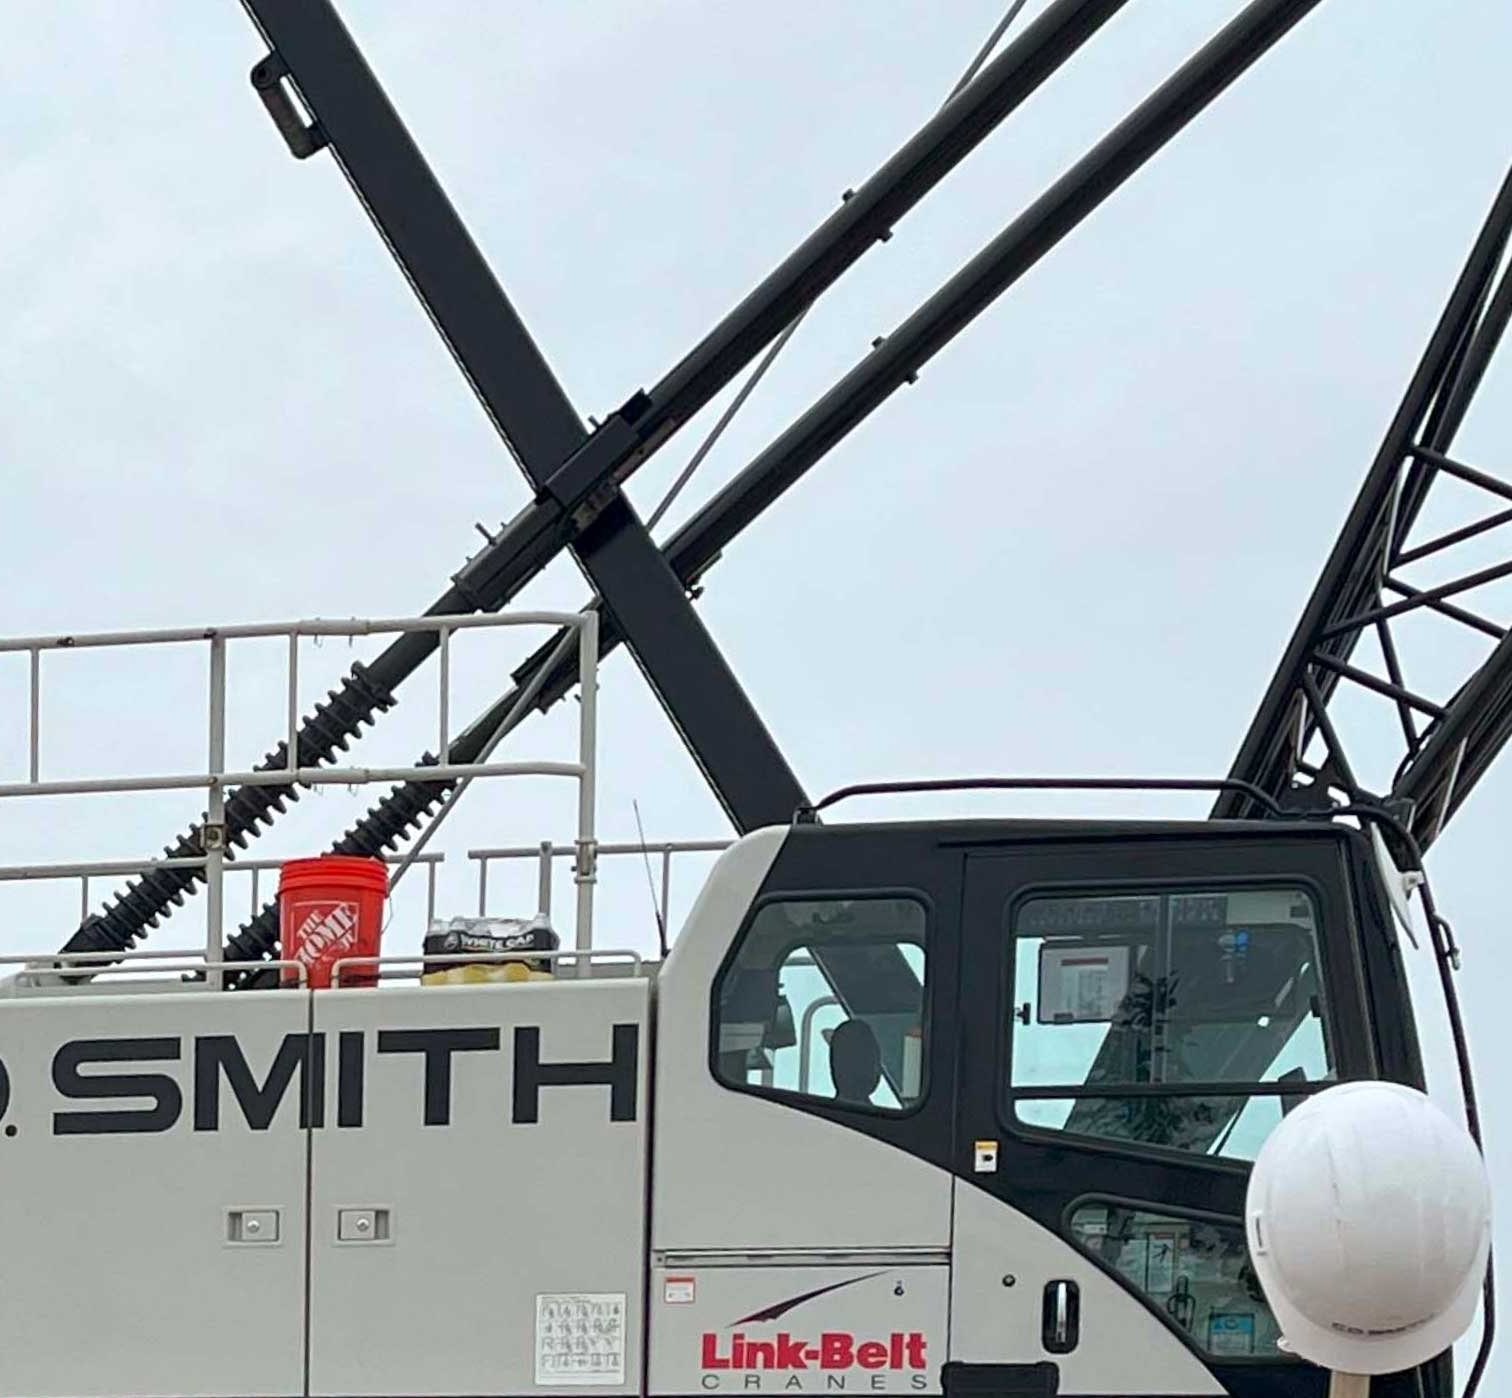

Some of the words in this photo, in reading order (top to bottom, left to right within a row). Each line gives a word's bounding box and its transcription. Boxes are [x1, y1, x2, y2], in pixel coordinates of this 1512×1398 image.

[296, 909, 326, 939] THE
[506, 933, 535, 948] CAP
[51, 1023, 639, 1134] SMITH
[701, 1332, 927, 1370] Link-Belt
[701, 1373, 928, 1390] CRANES
